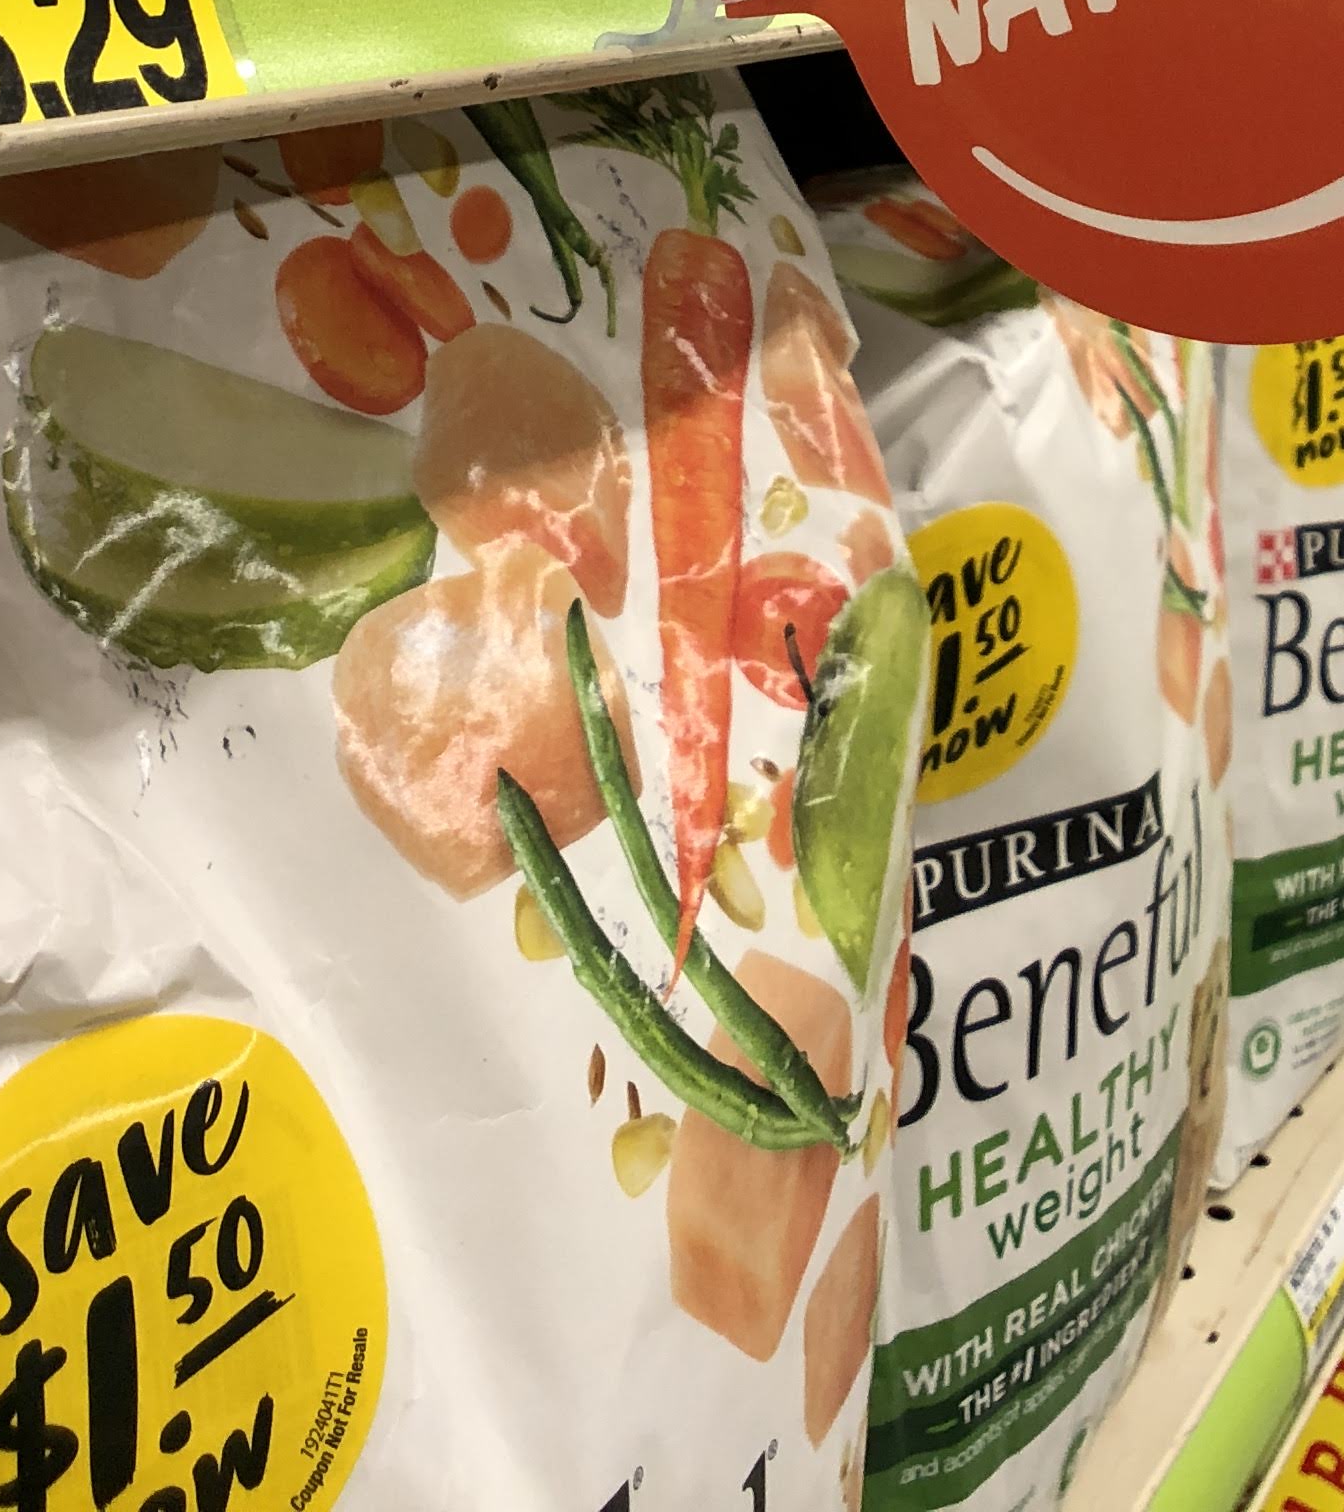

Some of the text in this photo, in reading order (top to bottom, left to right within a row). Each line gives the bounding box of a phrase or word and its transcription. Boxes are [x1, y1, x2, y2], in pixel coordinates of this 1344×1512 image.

[913, 789, 1162, 920] PURINA
[1274, 863, 1336, 902] WITH
[1306, 896, 1340, 927] THE
[917, 1005, 1180, 1232] HEALTHY
[987, 1116, 1145, 1259] weight
[903, 1325, 994, 1398] WITH
[1003, 1268, 1087, 1344] REAL
[290, 1438, 335, 1512] Coupon
[324, 1410, 348, 1453] Not
[336, 1374, 357, 1415] For
[300, 1370, 346, 1464] 1924041T1
[959, 1375, 1008, 1425] THE
[899, 1456, 940, 1486] and
